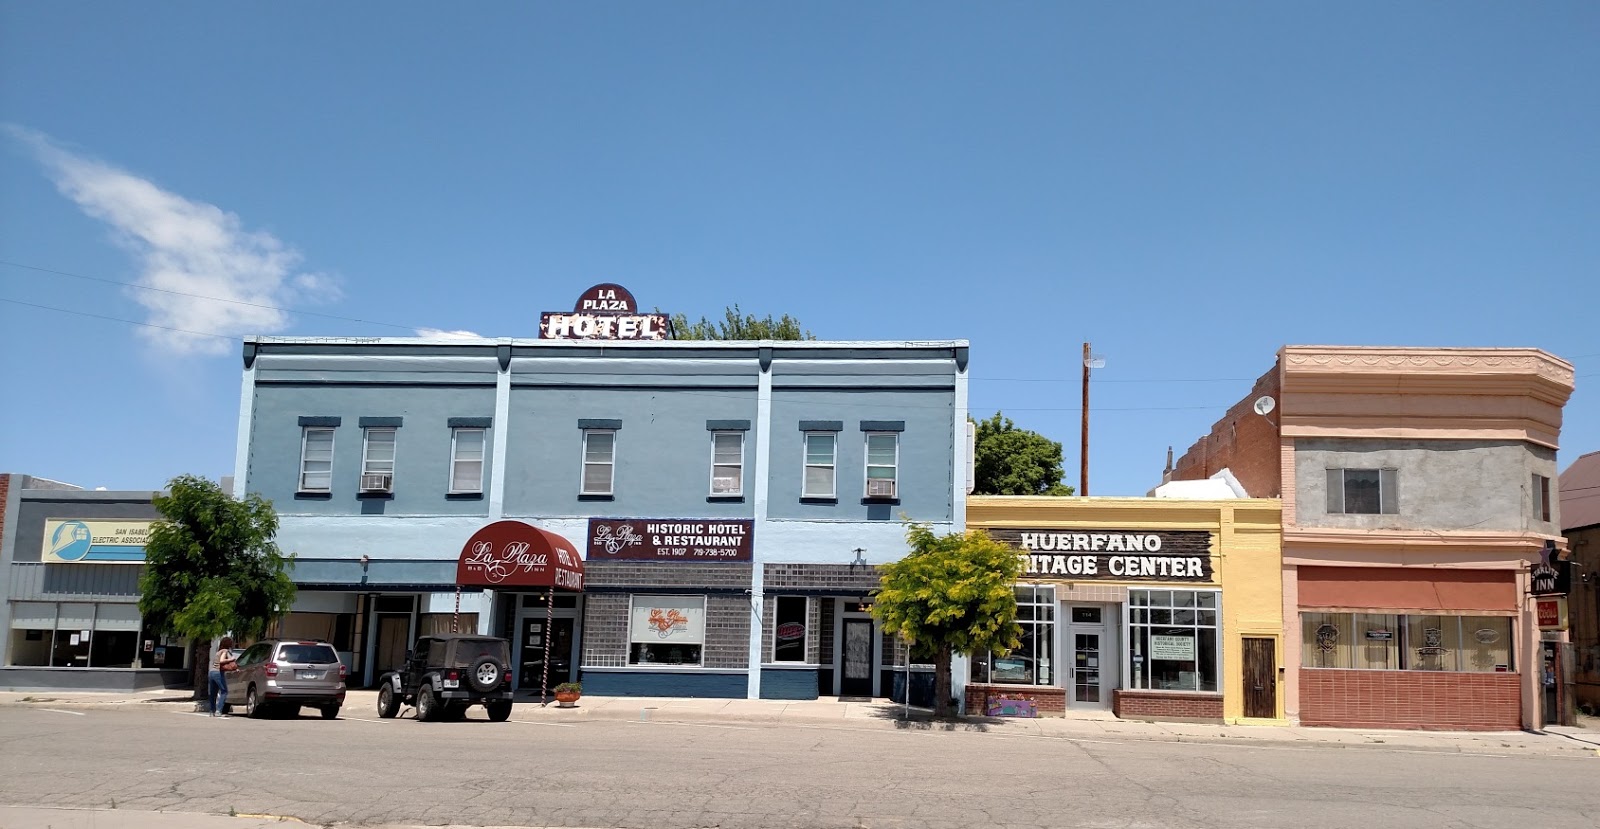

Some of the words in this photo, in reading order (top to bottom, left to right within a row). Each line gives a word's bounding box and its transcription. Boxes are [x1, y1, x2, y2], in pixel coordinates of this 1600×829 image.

[598, 289, 616, 299] LA
[583, 300, 628, 310] PLAZA
[547, 315, 659, 337] HOTEL
[129, 528, 149, 536] ISABEL
[593, 525, 614, 541] La
[615, 525, 644, 545] Plaza
[646, 523, 704, 534] HISTORIC
[708, 524, 746, 535] HOTEL
[91, 536, 119, 544] ELECTRIC
[652, 536, 662, 545] &
[664, 535, 743, 546] RESTAURANT
[1020, 532, 1162, 552] HUERFANO
[465, 540, 494, 564] La
[502, 541, 548, 573] Plaza
[657, 547, 671, 556] EST.
[672, 547, 687, 556] 1907
[693, 548, 738, 557] 719-738-5700
[1108, 556, 1204, 577] CENTER
[554, 567, 583, 590] RESTAURANT
[1531, 566, 1560, 581] STARLITE
[1535, 578, 1555, 591] INN
